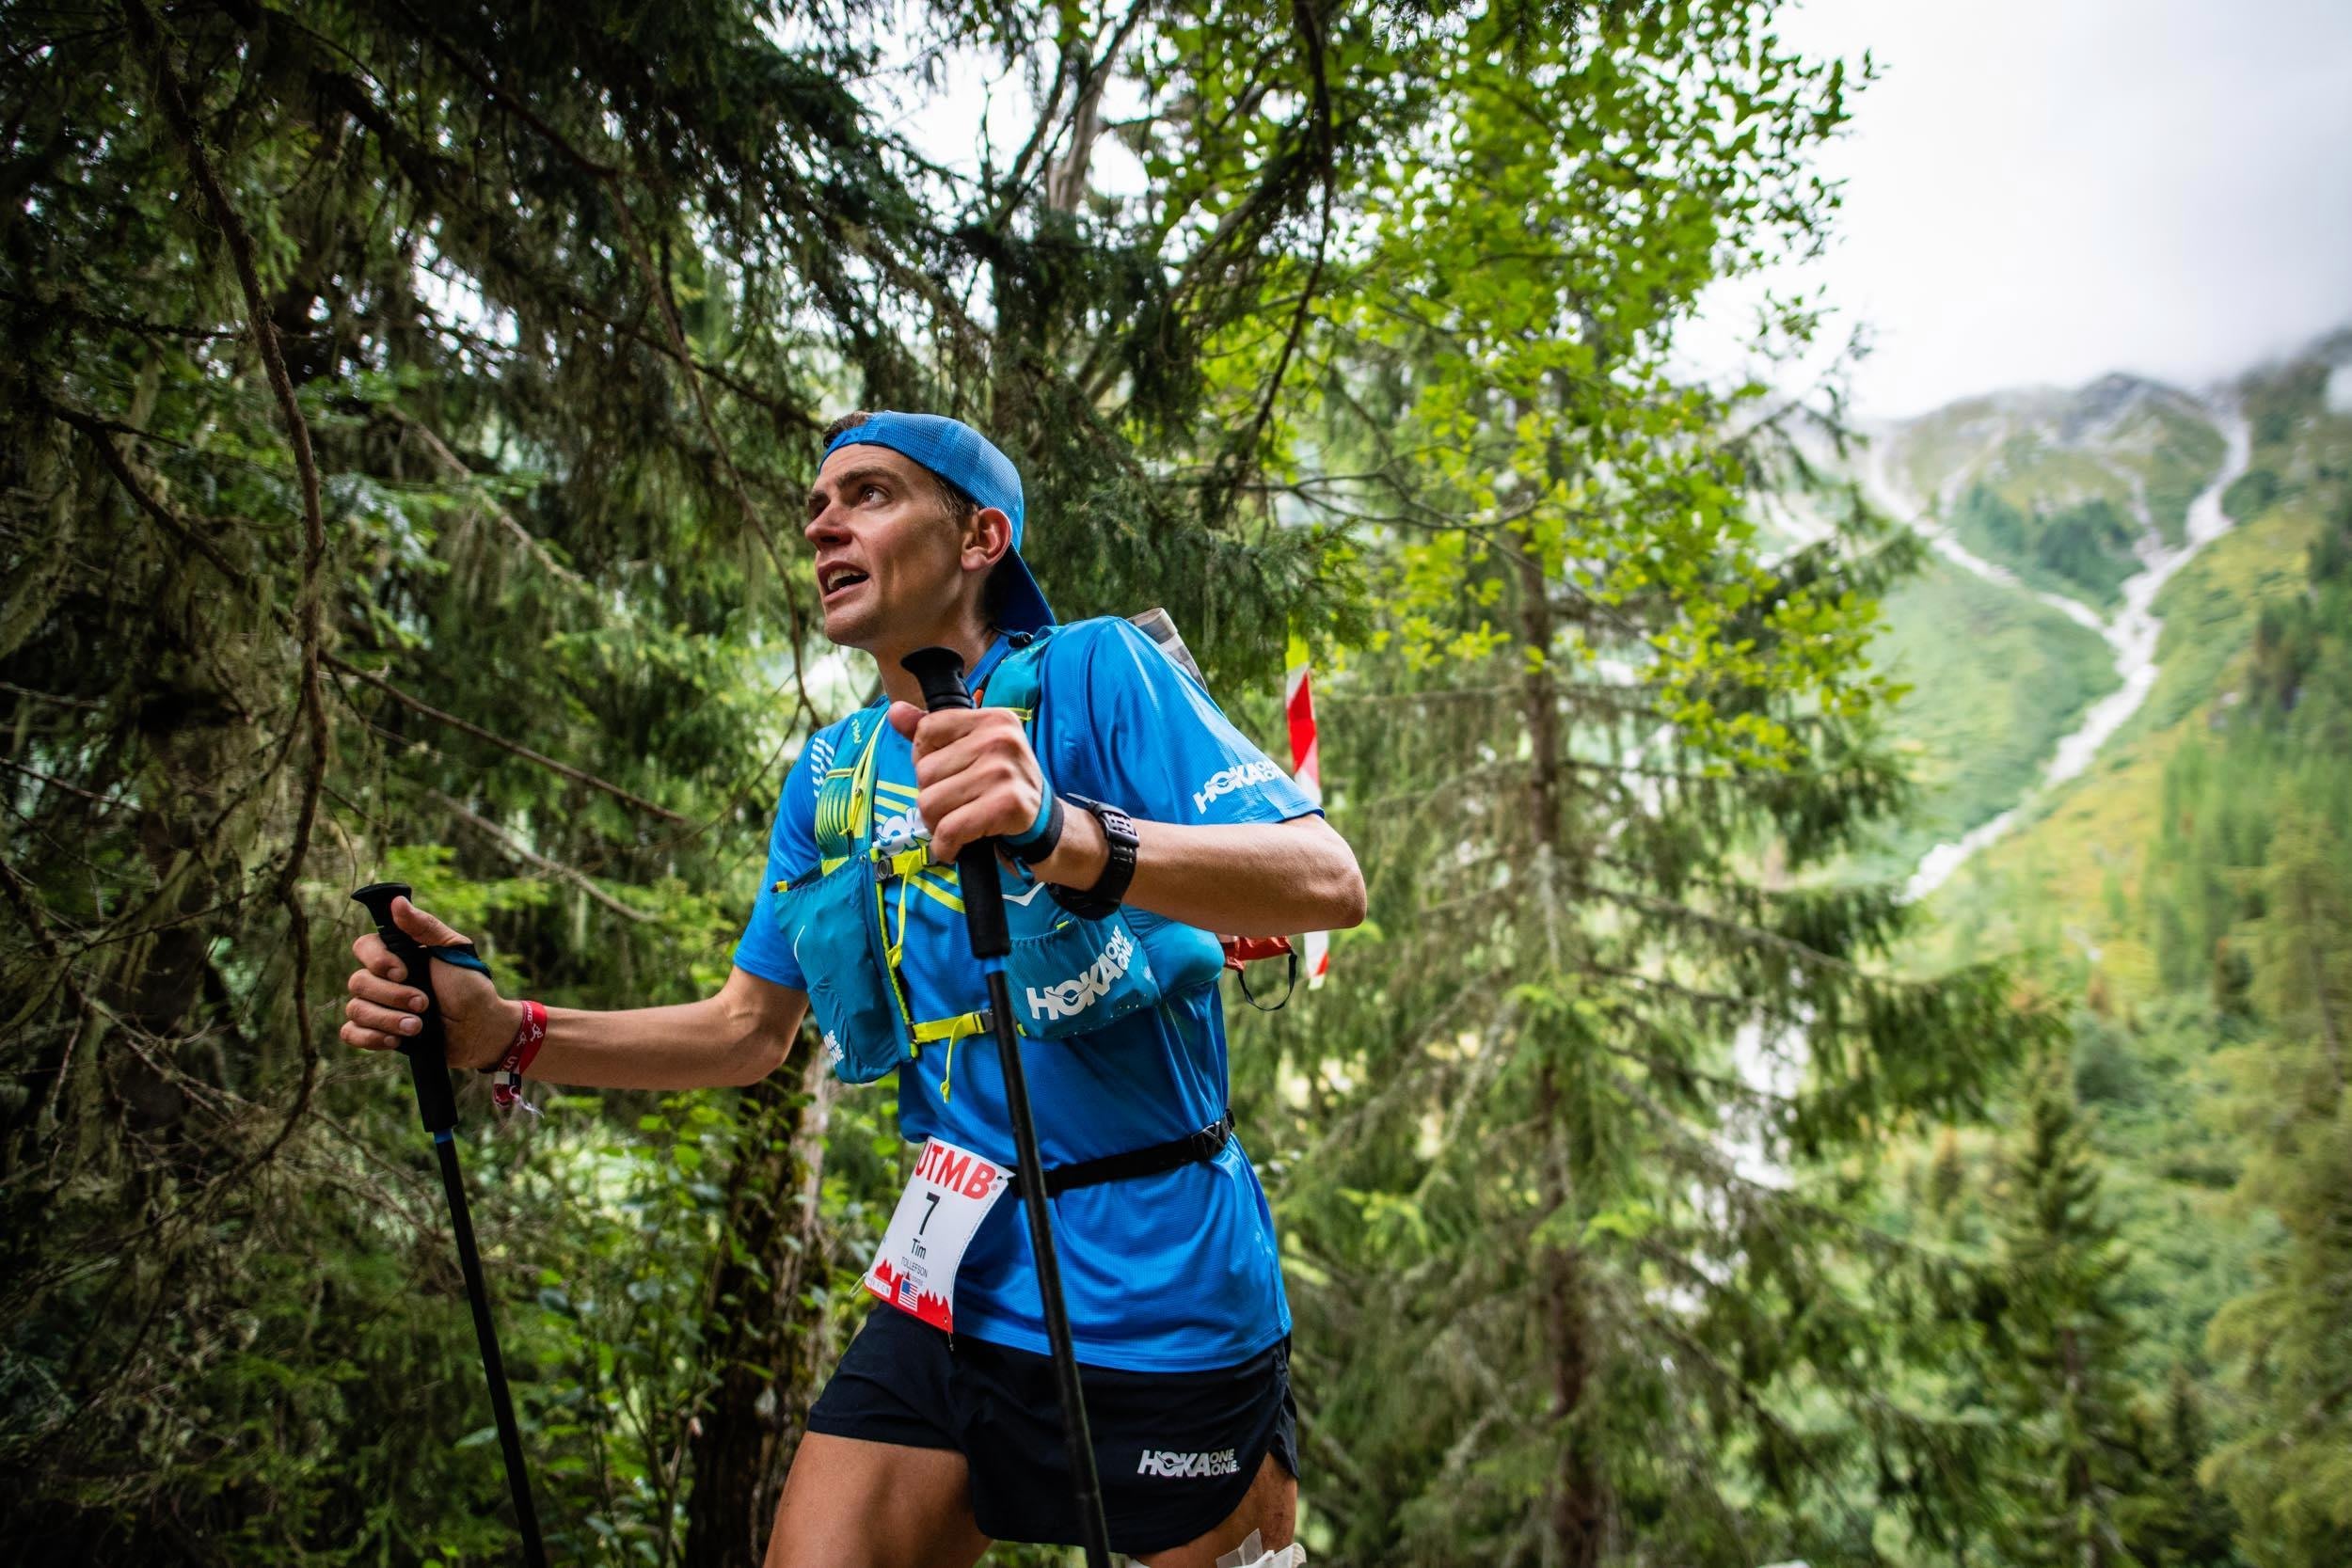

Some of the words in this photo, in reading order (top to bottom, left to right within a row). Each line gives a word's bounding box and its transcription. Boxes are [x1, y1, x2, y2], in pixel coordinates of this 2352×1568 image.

[1192, 763, 1268, 815] HOKA
[1026, 953, 1124, 1021] HOKA
[1105, 925, 1124, 960] ONE
[1117, 936, 1134, 971] ONE
[918, 1191, 940, 1236] 7
[911, 1237, 927, 1259] Tim
[1136, 1449, 1211, 1478] HOKA
[1210, 1449, 1235, 1464] ONE
